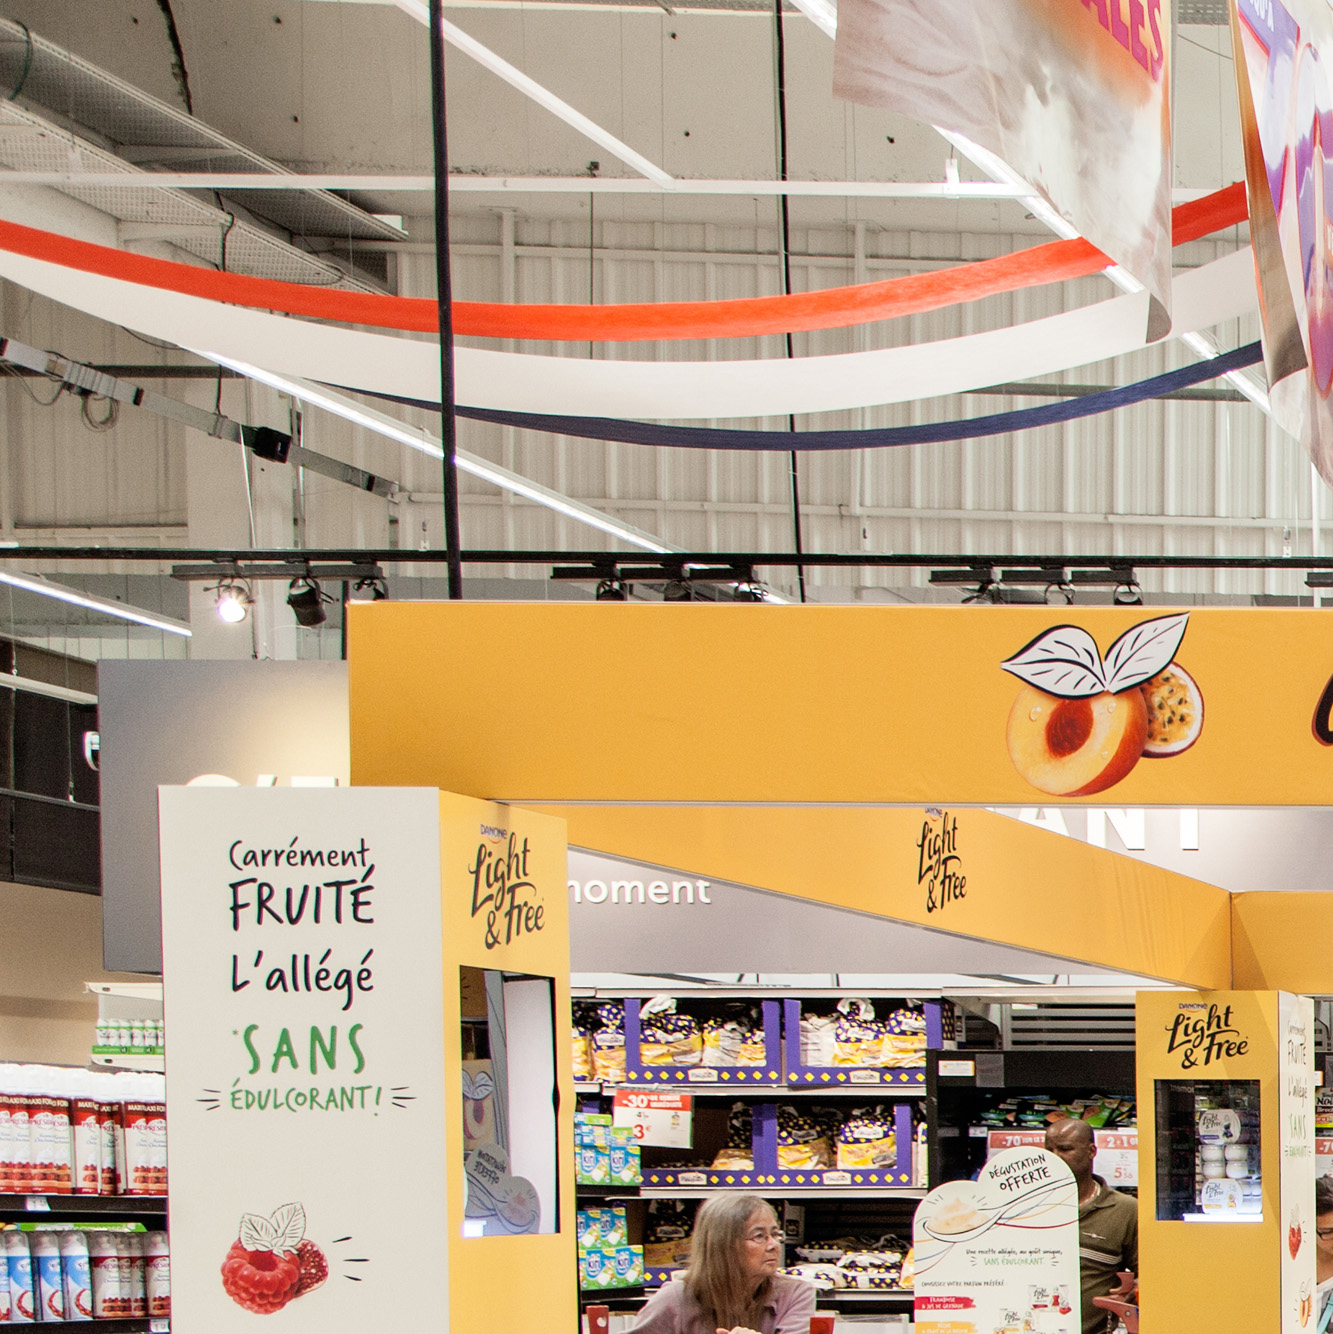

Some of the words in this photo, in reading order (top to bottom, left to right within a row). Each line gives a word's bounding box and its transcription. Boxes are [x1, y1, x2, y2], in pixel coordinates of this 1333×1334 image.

[229, 836, 370, 871] Carrément
[916, 812, 958, 885] Light
[229, 864, 375, 931] FRUITÉ
[467, 832, 531, 918] Light
[927, 879, 937, 913] &
[941, 855, 967, 910] Free
[483, 913, 502, 949] &
[504, 882, 545, 945] Free
[231, 948, 374, 1011] L'allégé
[1165, 1004, 1234, 1054] Light
[1181, 1048, 1198, 1069] &
[1204, 1030, 1249, 1066] Free
[230, 1077, 383, 1116] ÉDULCORANT!
[989, 1154, 1046, 1179] DÉGUSTATION
[999, 1168, 1051, 1191] OFFERTE
[984, 1257, 999, 1266] SANS
